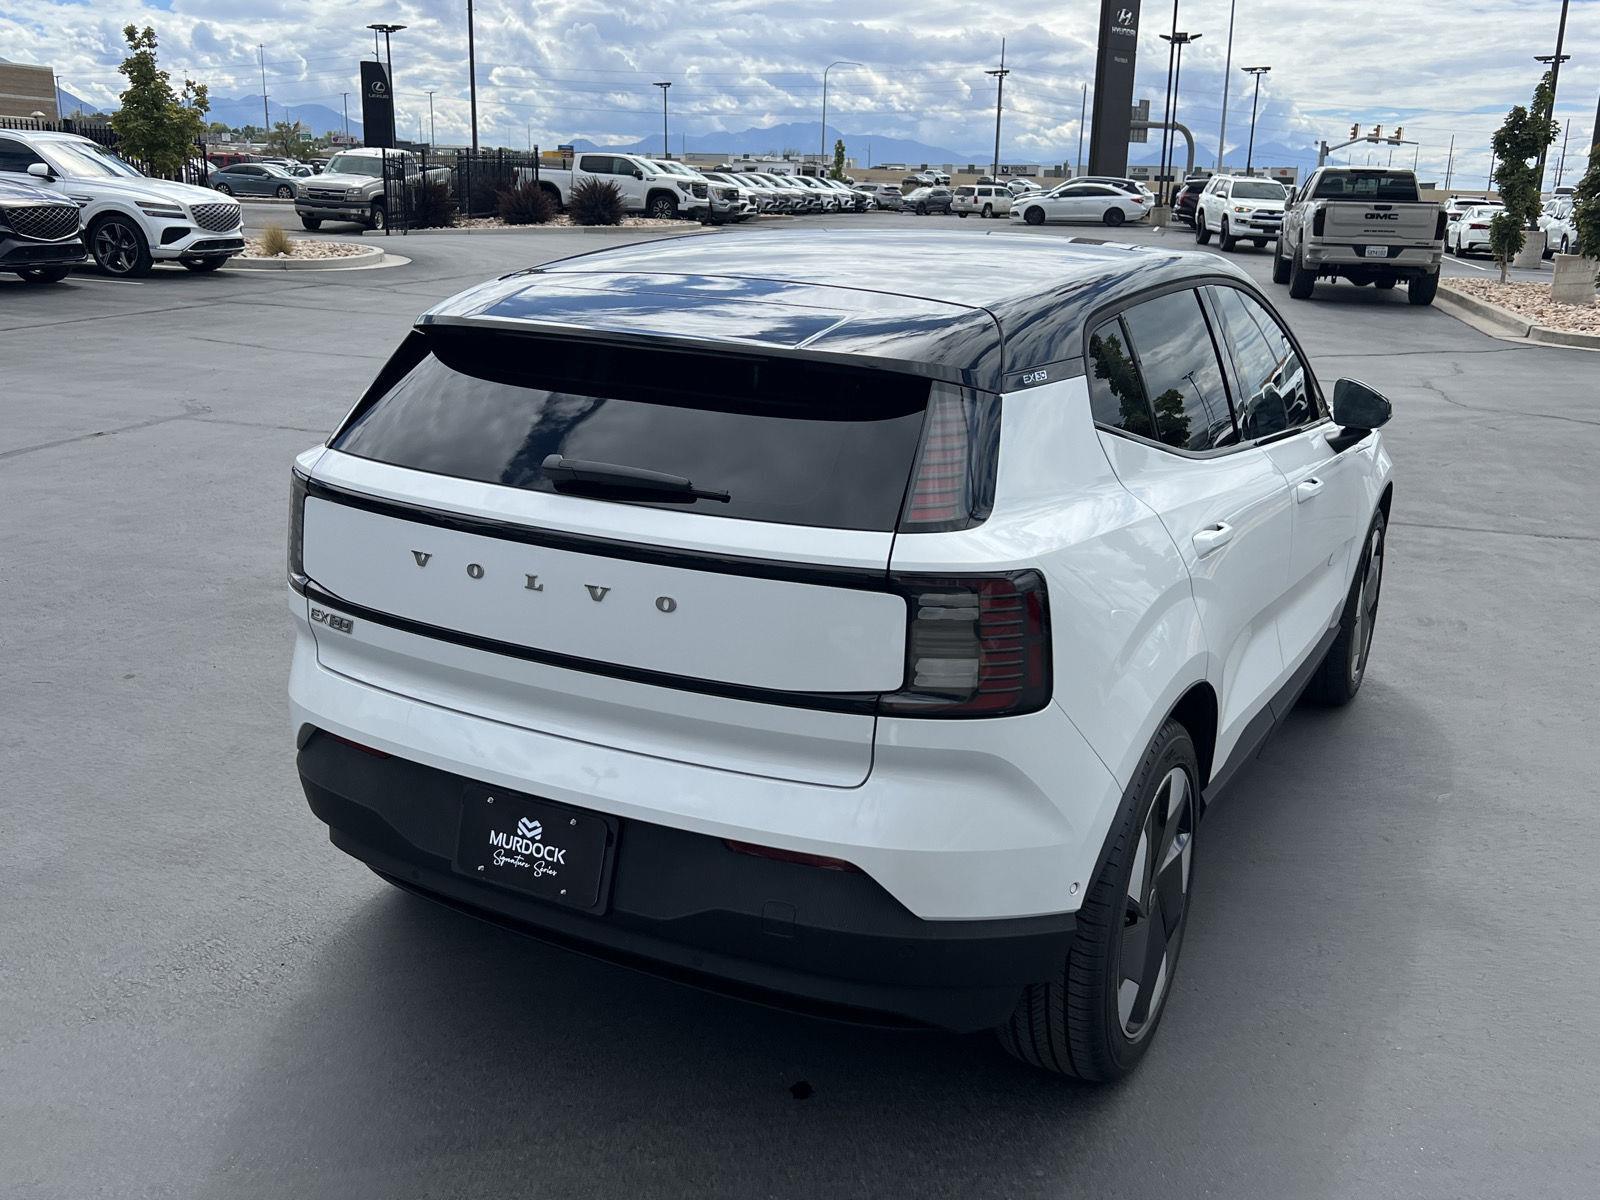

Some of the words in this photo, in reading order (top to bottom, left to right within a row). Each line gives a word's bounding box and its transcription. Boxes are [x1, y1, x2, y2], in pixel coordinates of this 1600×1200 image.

[411, 550, 677, 614] VOLVO
[489, 830, 567, 865] MURDOCK
[493, 849, 531, 866] Signature
[533, 860, 558, 878] Series
